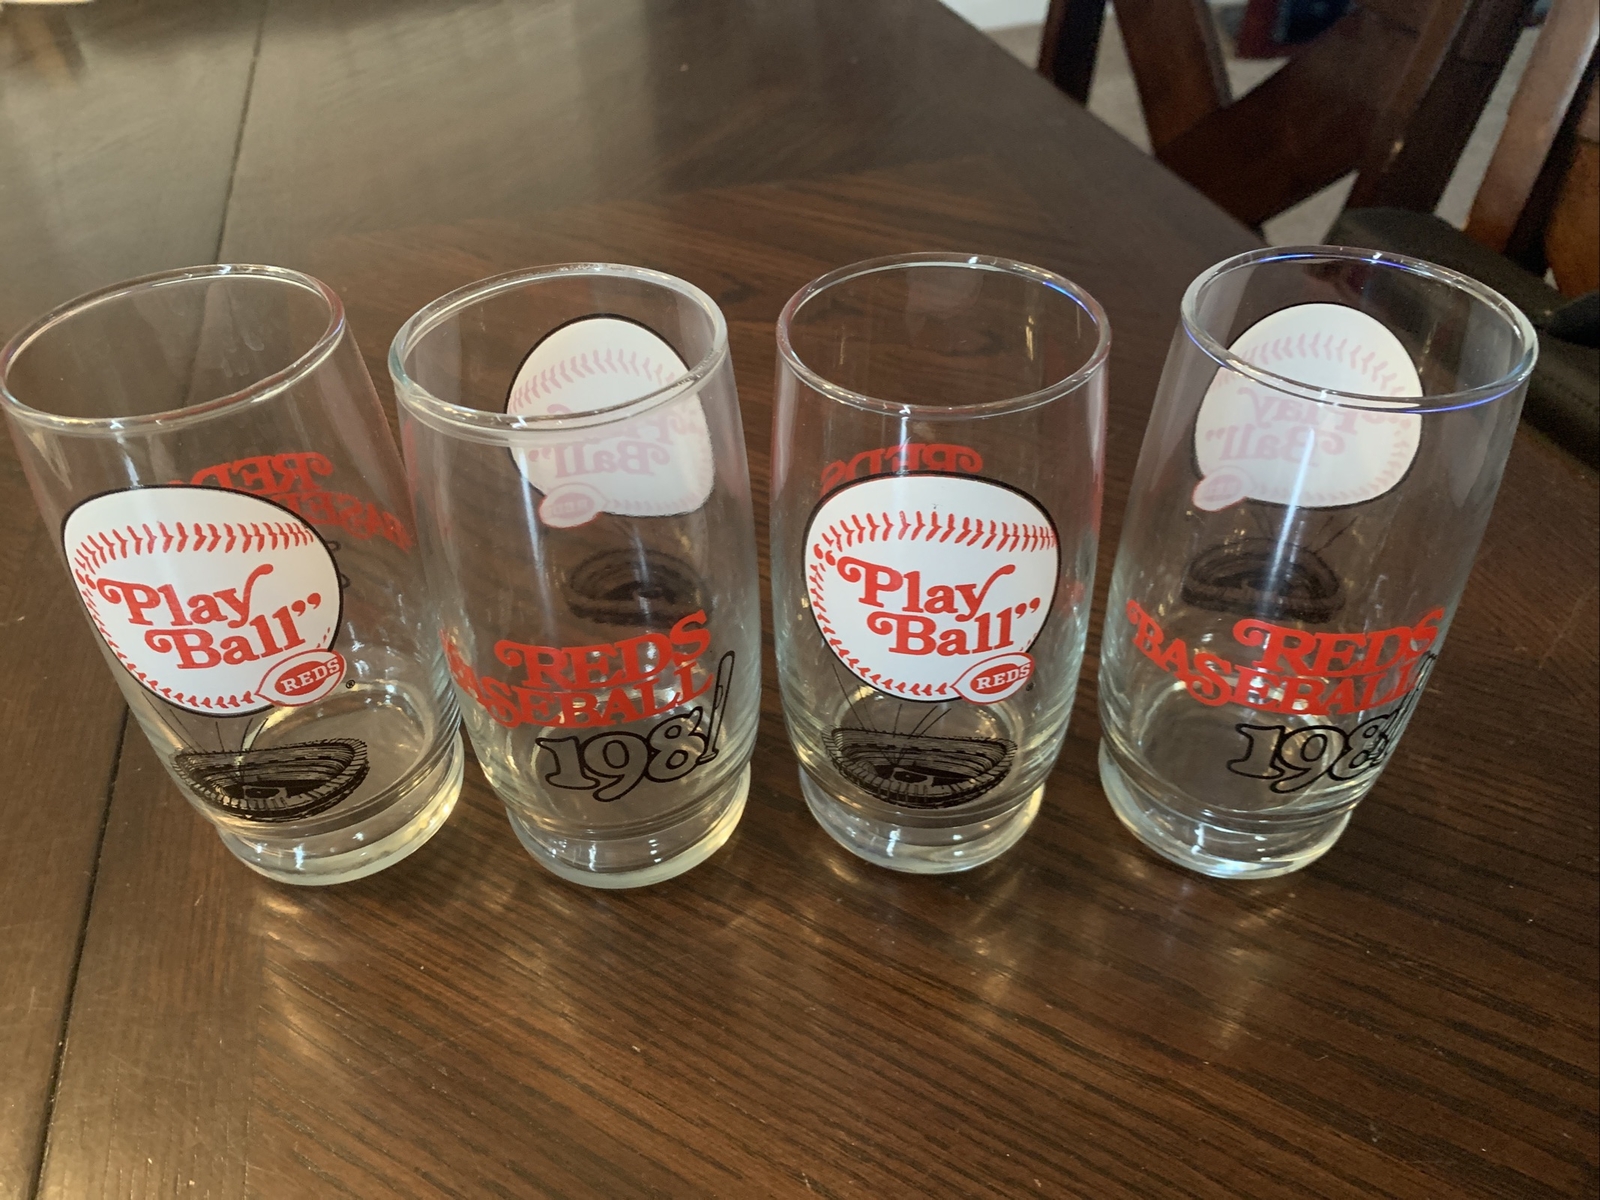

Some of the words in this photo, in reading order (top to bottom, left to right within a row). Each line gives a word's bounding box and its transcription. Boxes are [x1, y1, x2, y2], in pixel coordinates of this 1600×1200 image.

[280, 656, 342, 693] REDS
[494, 609, 712, 690] REDS
[976, 663, 1031, 690] REDS
[1126, 599, 1424, 716] BASEBALL
[1232, 606, 1446, 678] REDS
[535, 650, 735, 802] 1981
